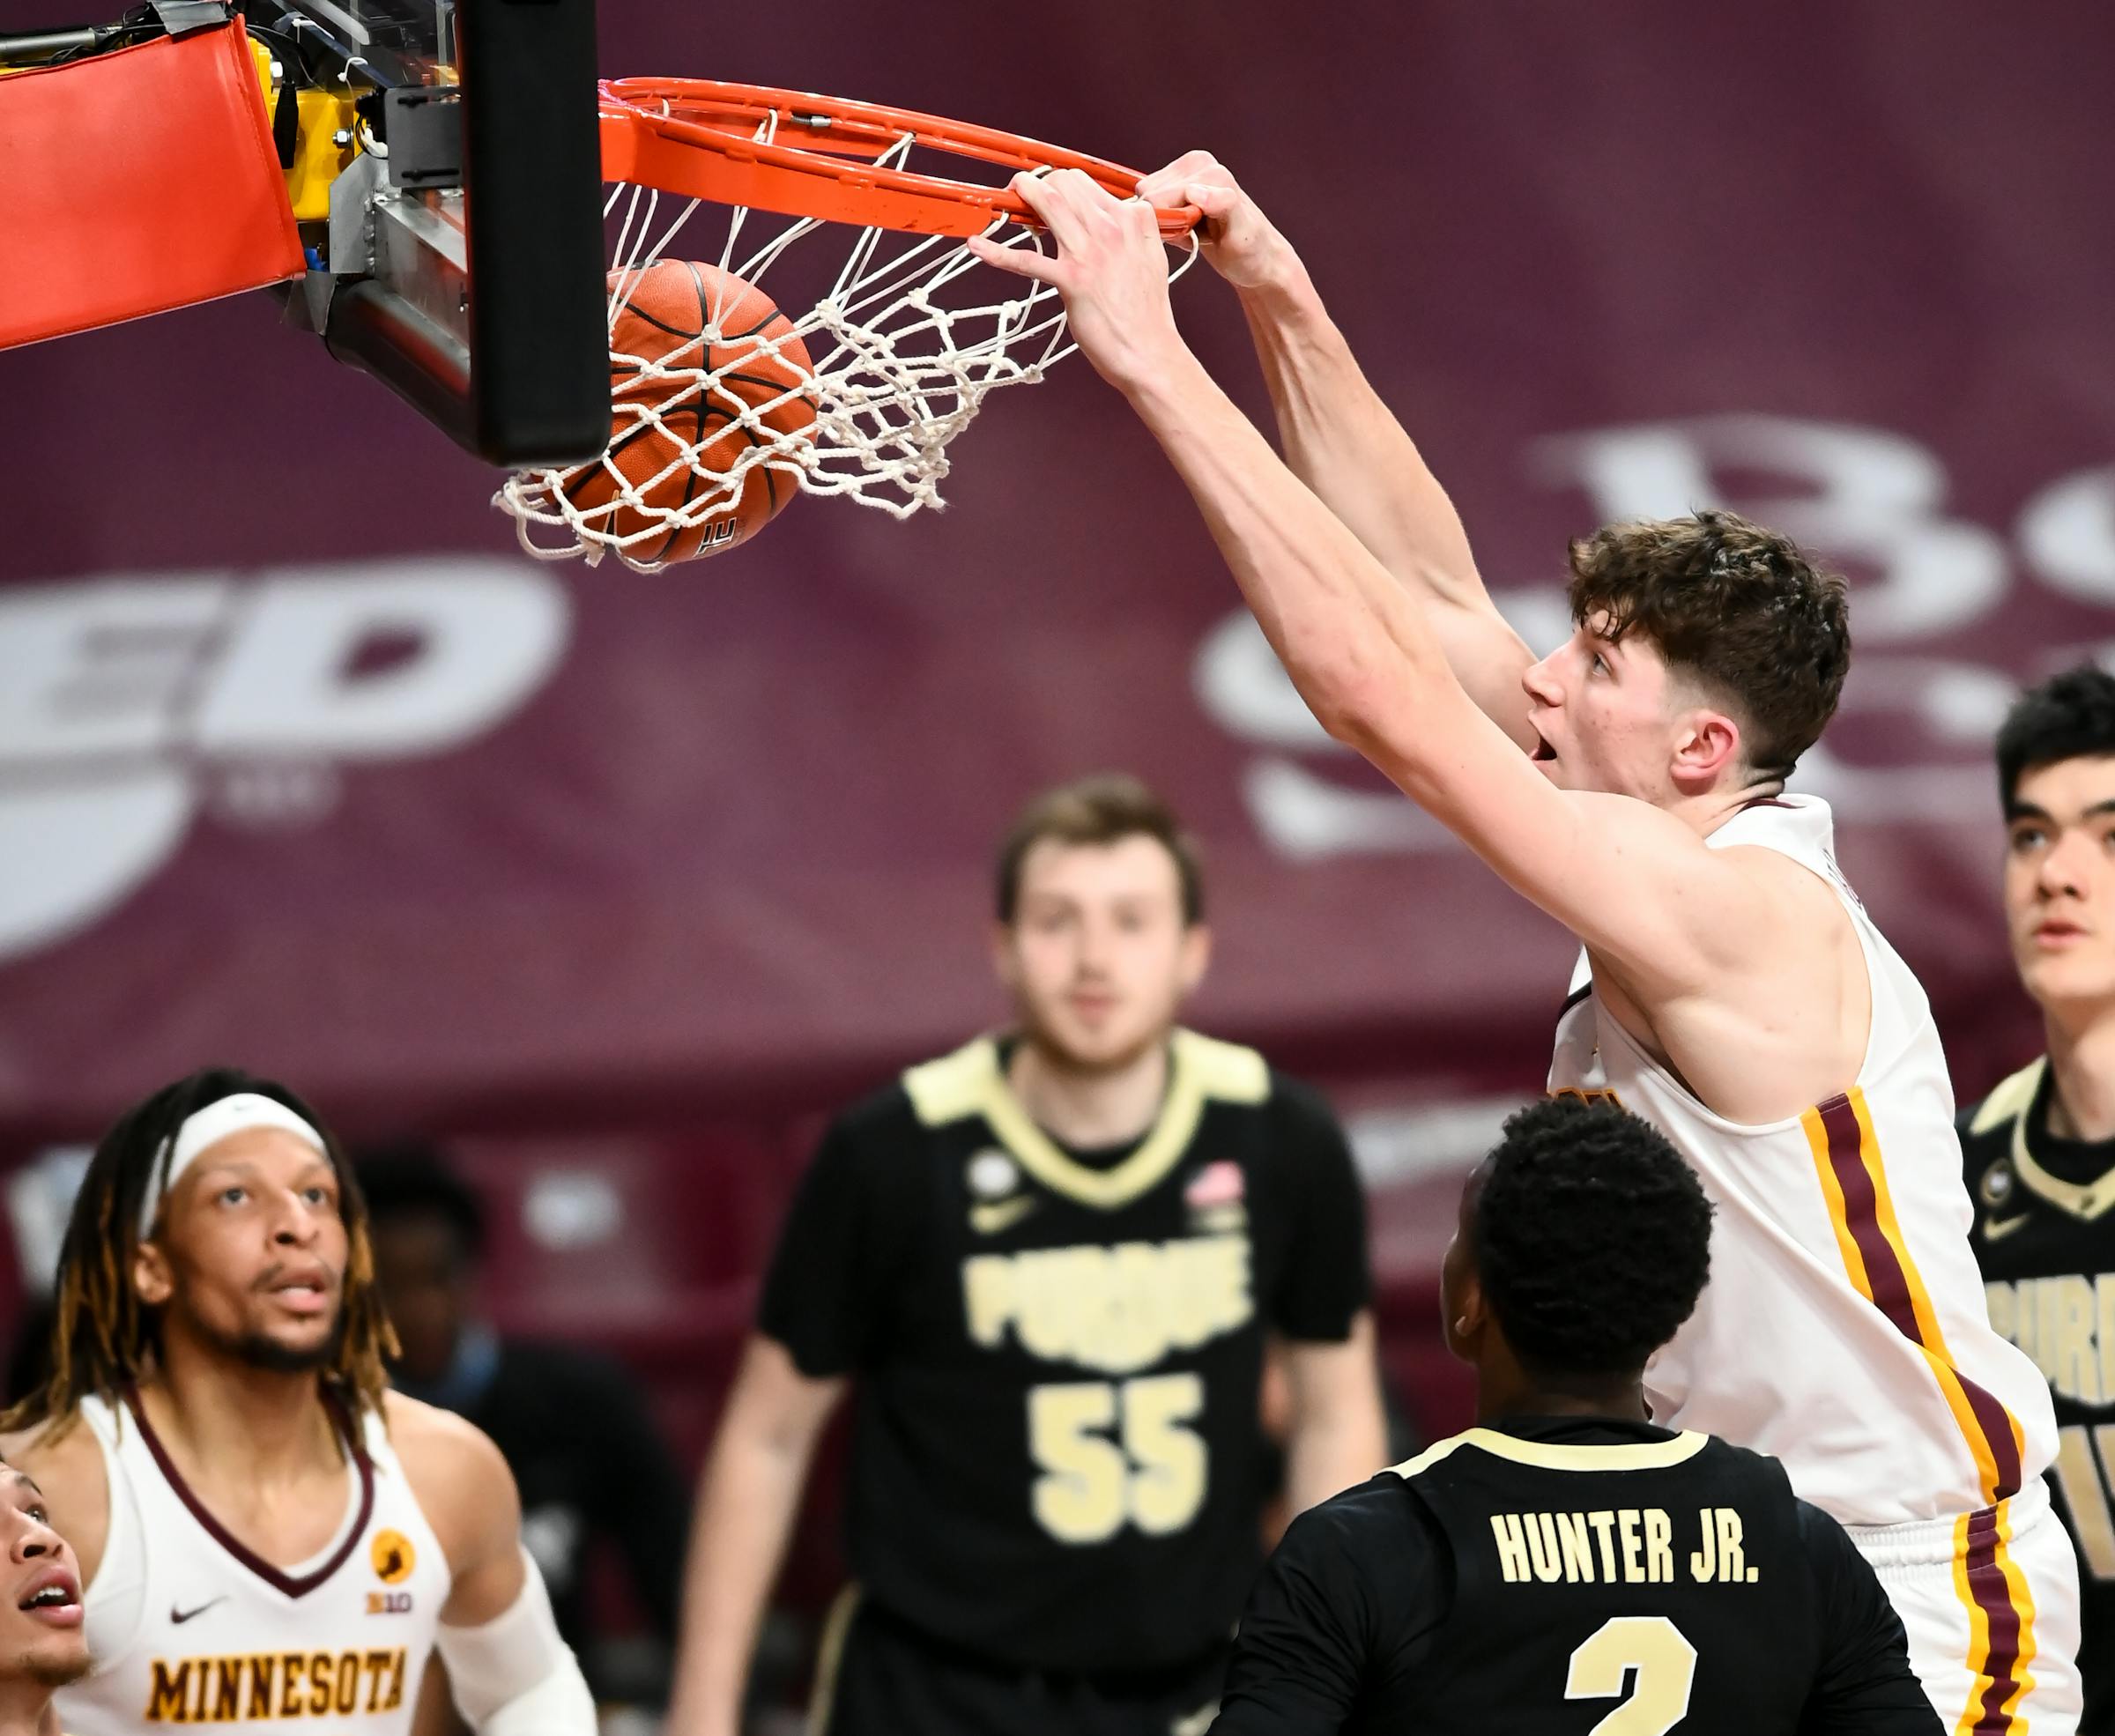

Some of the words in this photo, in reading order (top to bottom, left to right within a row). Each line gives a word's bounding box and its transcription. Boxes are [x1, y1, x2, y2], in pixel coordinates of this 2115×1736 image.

[1028, 1371, 1208, 1544] 55
[1489, 1509, 1674, 1584] HUNTER
[1690, 1508, 1759, 1583] JR.
[1564, 1616, 1698, 1736] 2
